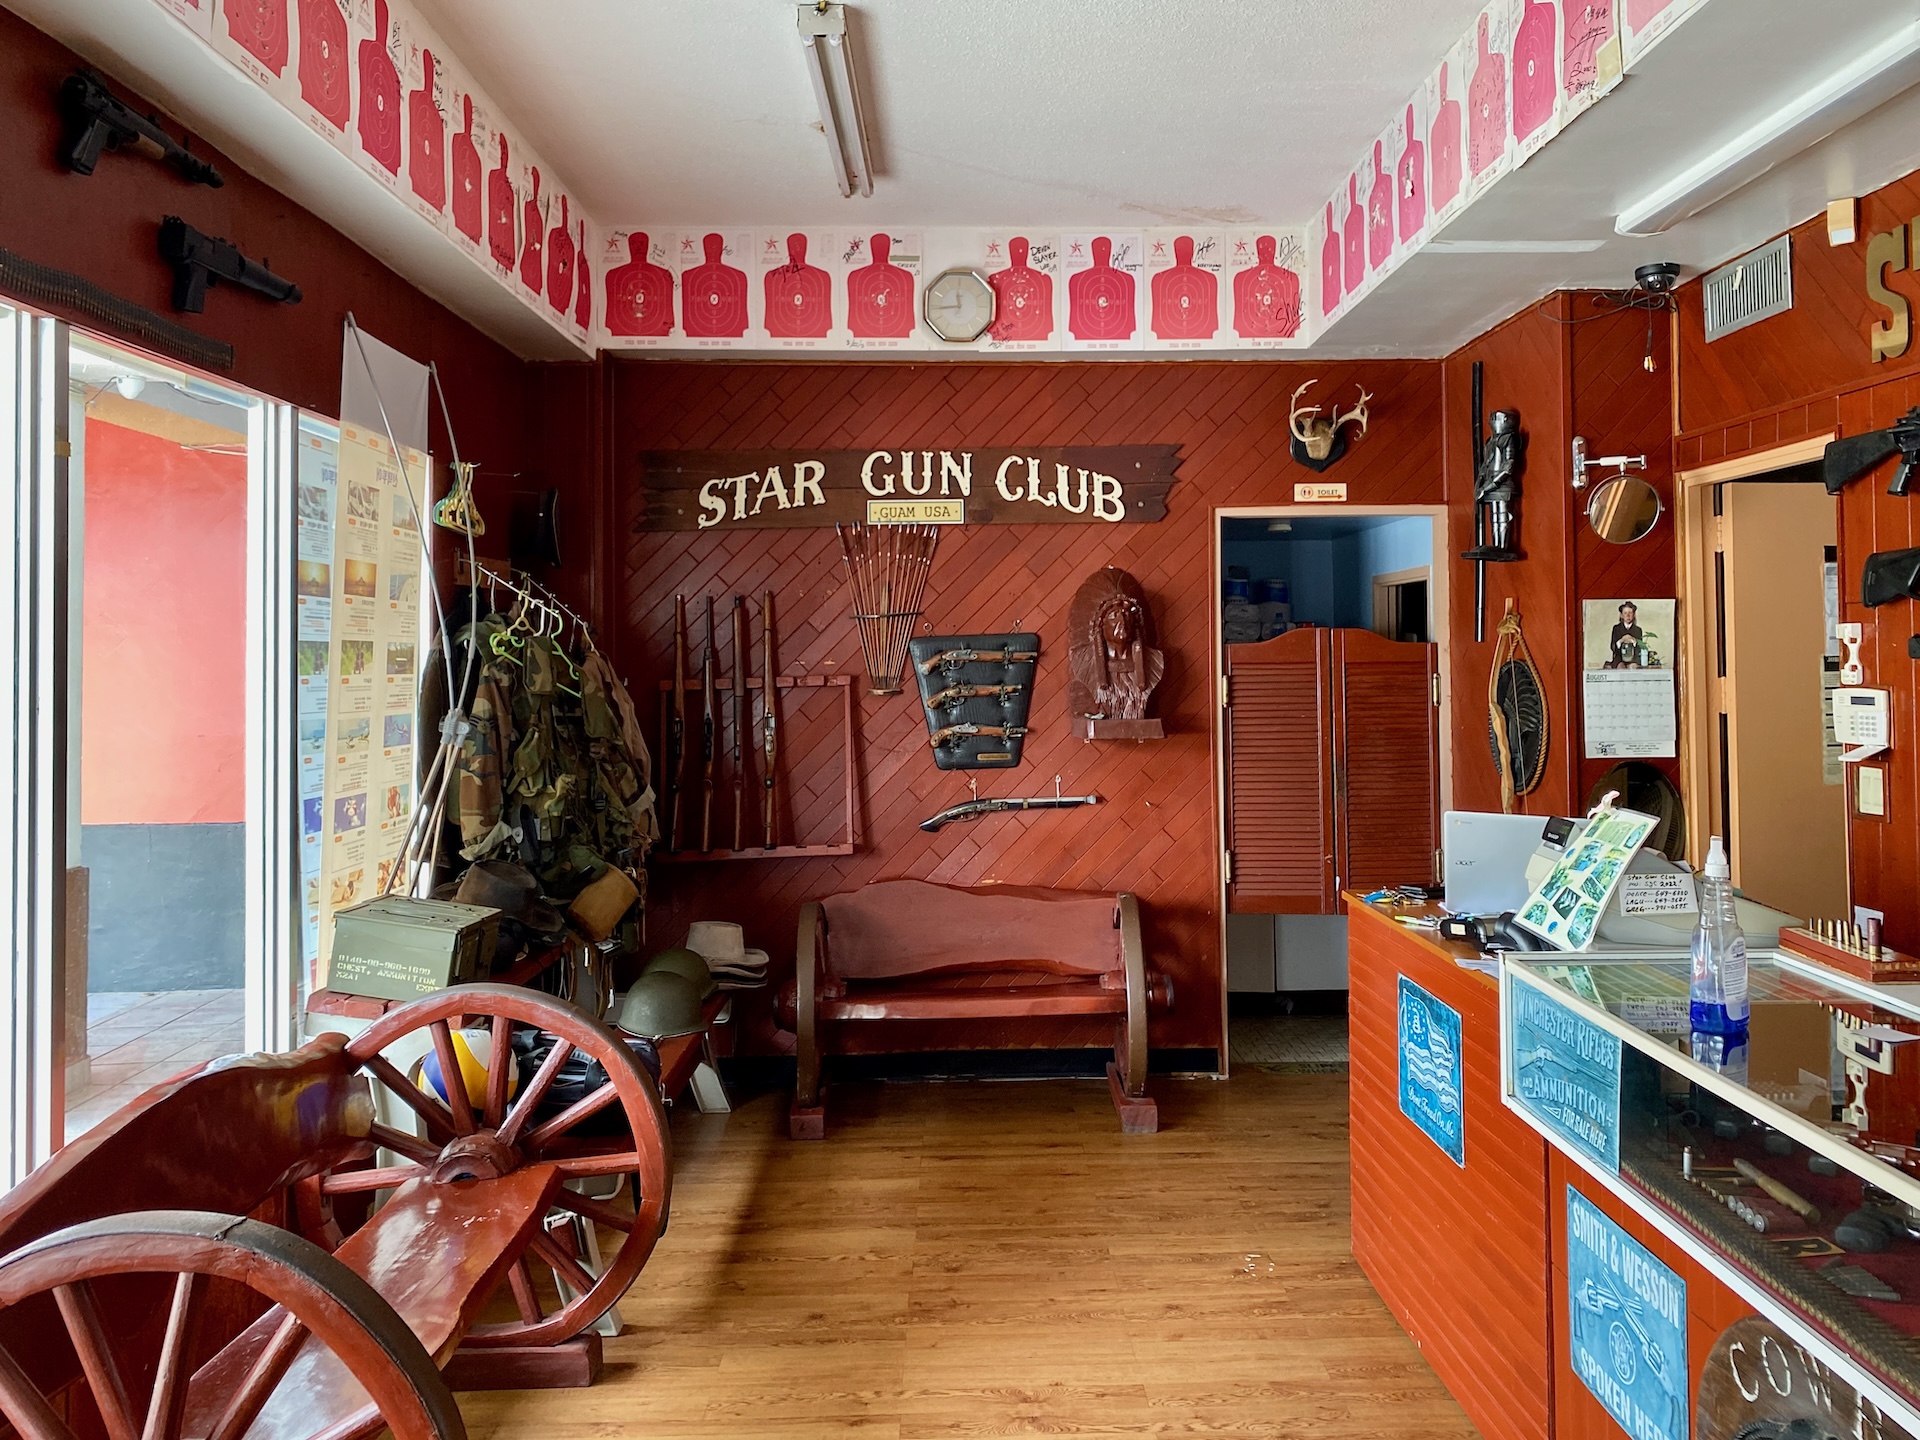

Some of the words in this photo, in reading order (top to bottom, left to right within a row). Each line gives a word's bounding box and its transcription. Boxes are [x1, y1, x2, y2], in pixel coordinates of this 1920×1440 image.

[1866, 213, 1920, 364] S
[697, 460, 826, 530] STAR
[860, 450, 973, 497] GUN
[995, 454, 1127, 523] CLUB
[879, 506, 916, 519] GUAM
[924, 506, 951, 519] USA
[1516, 987, 1575, 1048] WINCHESTER
[1576, 1020, 1615, 1071] RIFLES
[1522, 1077, 1533, 1089] AND
[1525, 1074, 1607, 1127] AMMUNITION
[1561, 1106, 1574, 1129] FOR
[1574, 1114, 1588, 1142] SALE
[1588, 1126, 1608, 1153] HERE
[1573, 1201, 1608, 1265] SMITH
[1610, 1234, 1620, 1276] &
[1621, 1242, 1679, 1330] WESSON
[1580, 1347, 1631, 1428] SPOKEN
[1634, 1403, 1672, 1440] HE
